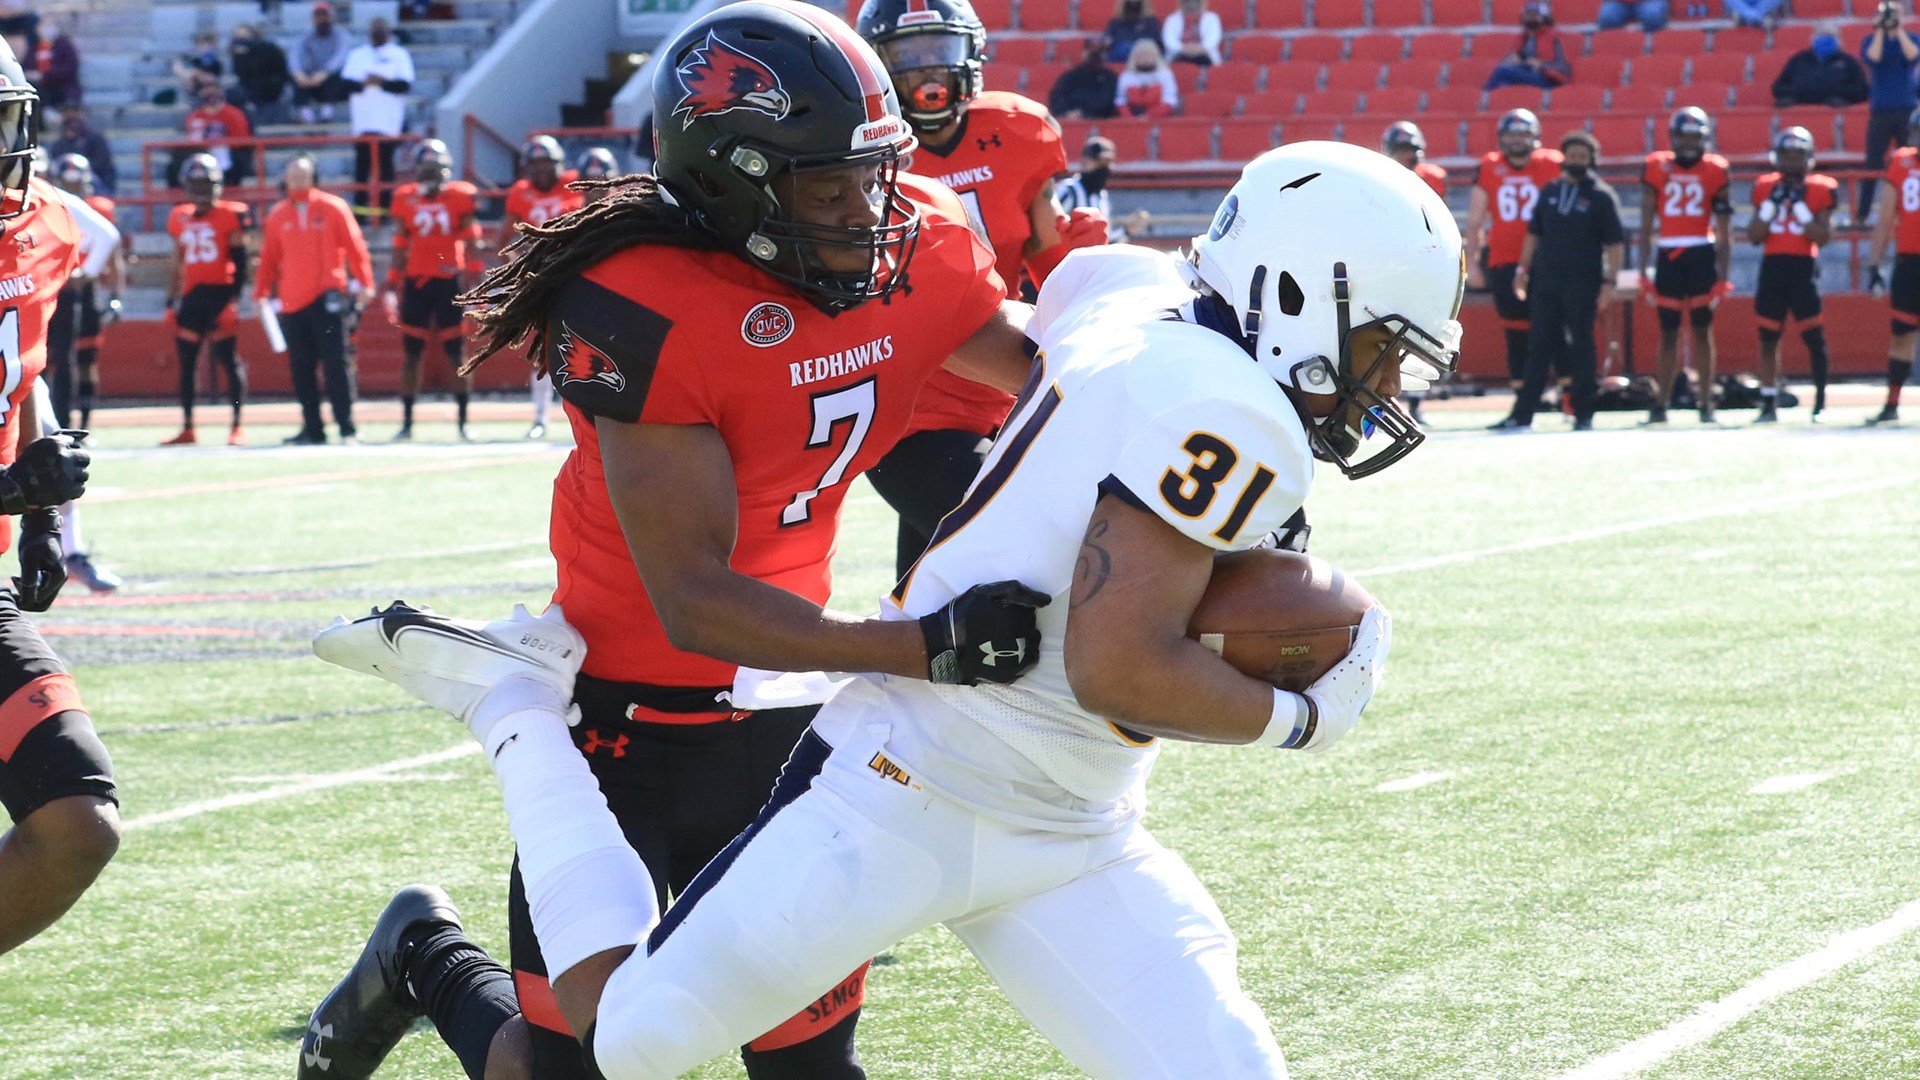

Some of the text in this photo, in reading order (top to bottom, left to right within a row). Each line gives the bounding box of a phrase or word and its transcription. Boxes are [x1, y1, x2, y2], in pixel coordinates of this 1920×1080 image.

[938, 165, 993, 188] HAWKS
[1664, 181, 1705, 217] 22
[1498, 184, 1538, 222] 62
[789, 335, 894, 387] REDHAWKS
[778, 373, 878, 529] 7
[1158, 430, 1278, 544] 31
[806, 977, 861, 1023] SEMO
